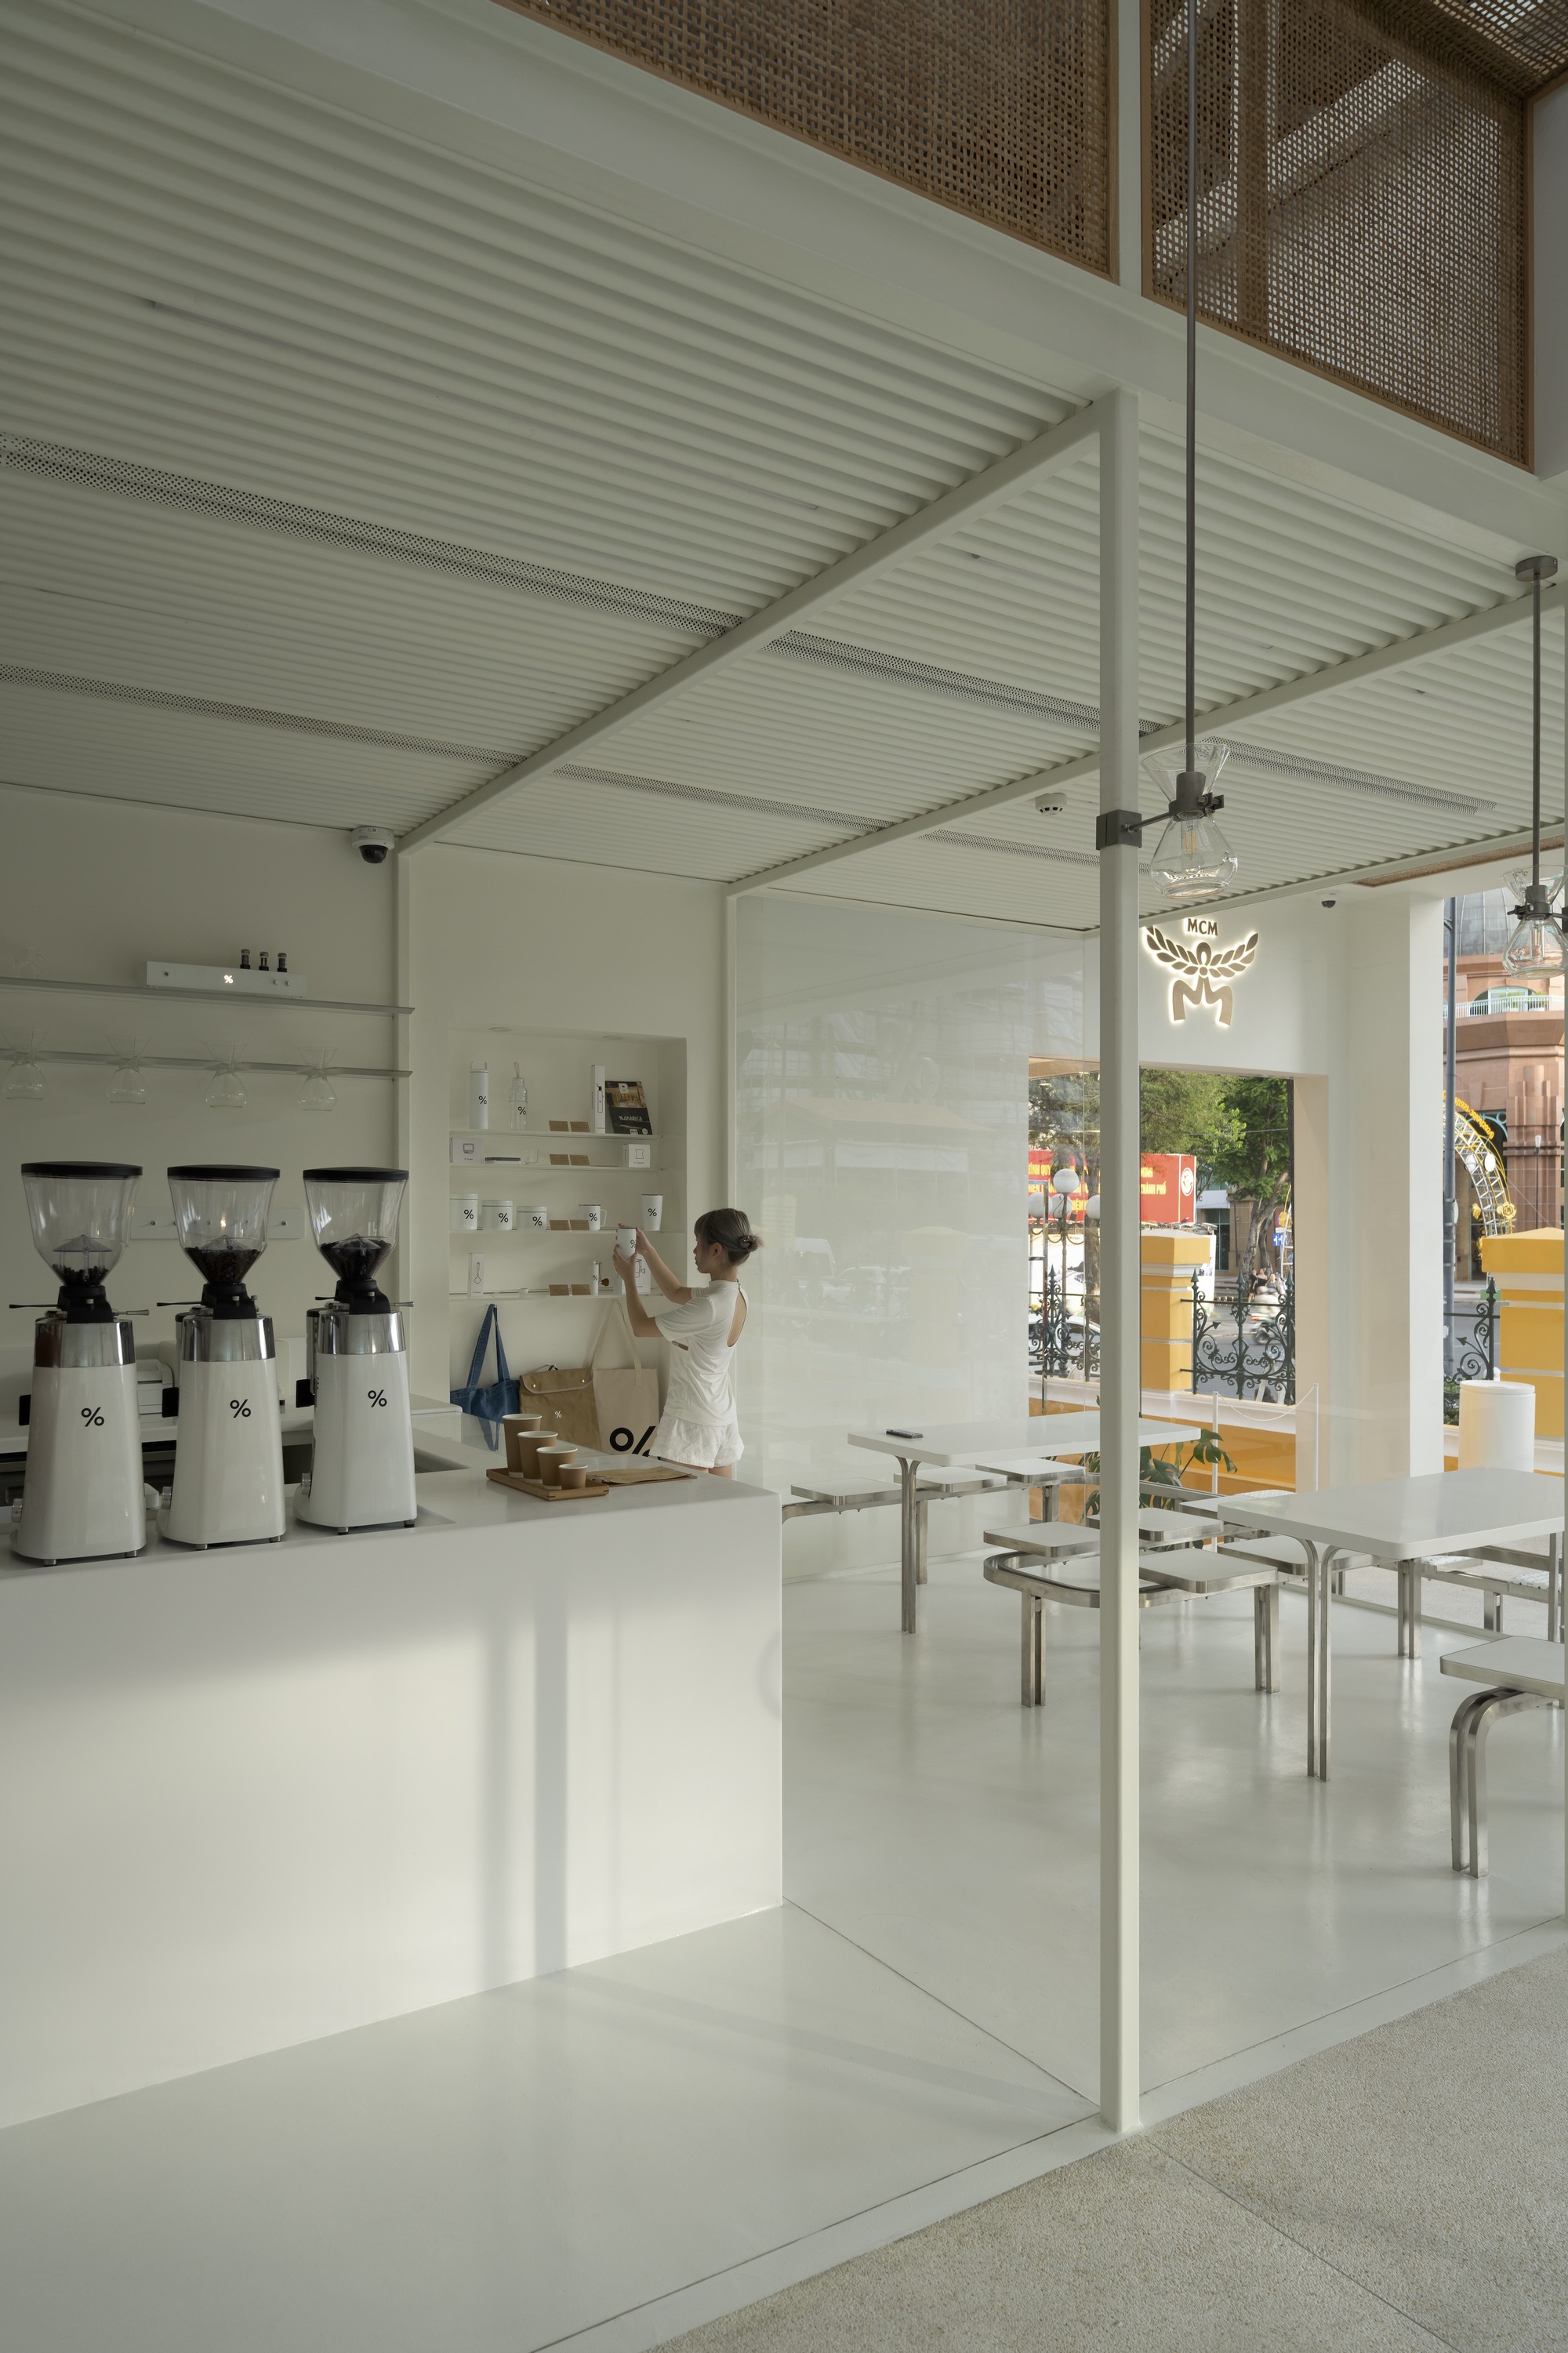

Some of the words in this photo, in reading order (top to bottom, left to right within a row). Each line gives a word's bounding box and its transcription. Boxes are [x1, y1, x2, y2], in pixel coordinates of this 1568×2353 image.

[1187, 918, 1218, 936] MCM
[618, 1083, 629, 1094] B
[478, 1095, 488, 1105] %
[517, 1106, 526, 1115] %
[463, 1209, 474, 1220] %
[498, 1212, 509, 1223] %
[589, 1212, 597, 1222] %
[648, 1207, 658, 1217] %
[532, 1216, 543, 1226] %
[368, 1389, 387, 1408] %
[230, 1399, 252, 1418] %
[81, 1407, 105, 1427] %
[554, 1411, 562, 1419] %
